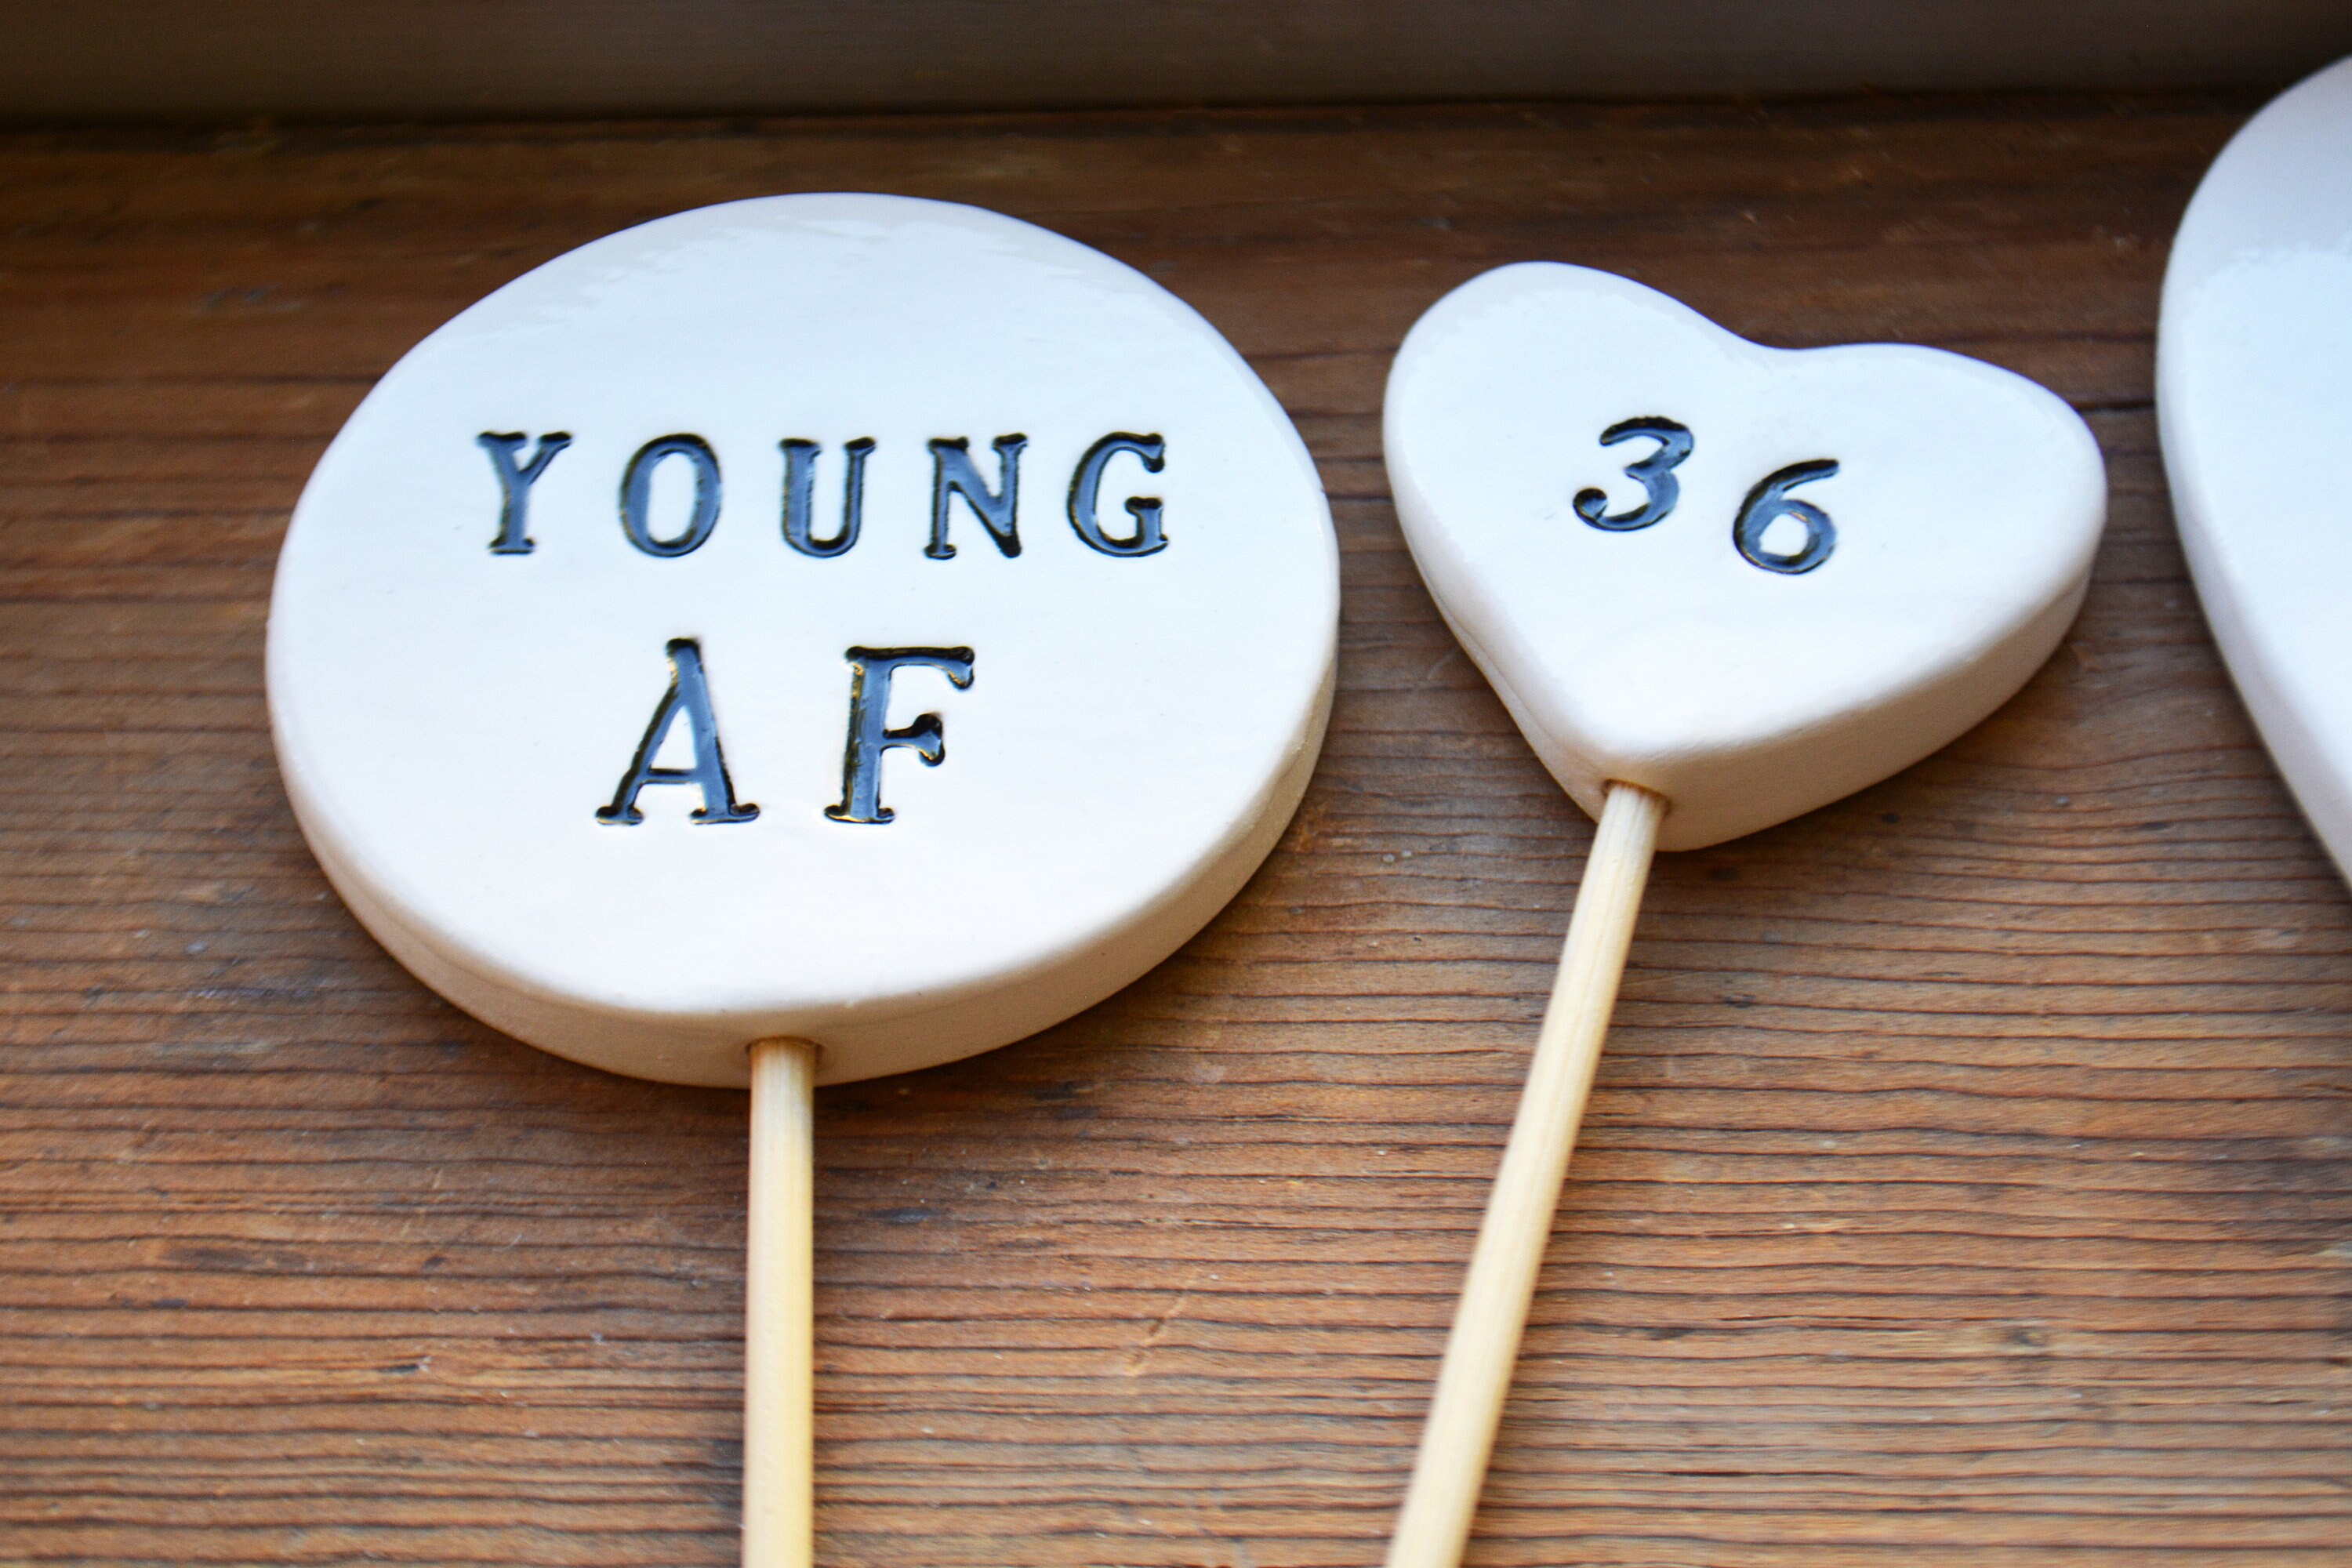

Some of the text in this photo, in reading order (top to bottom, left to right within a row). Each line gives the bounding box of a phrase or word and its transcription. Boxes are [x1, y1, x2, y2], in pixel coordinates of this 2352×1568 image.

[476, 430, 1171, 561] YOUNG
[1571, 415, 1841, 576] 36
[594, 637, 976, 826] AF
